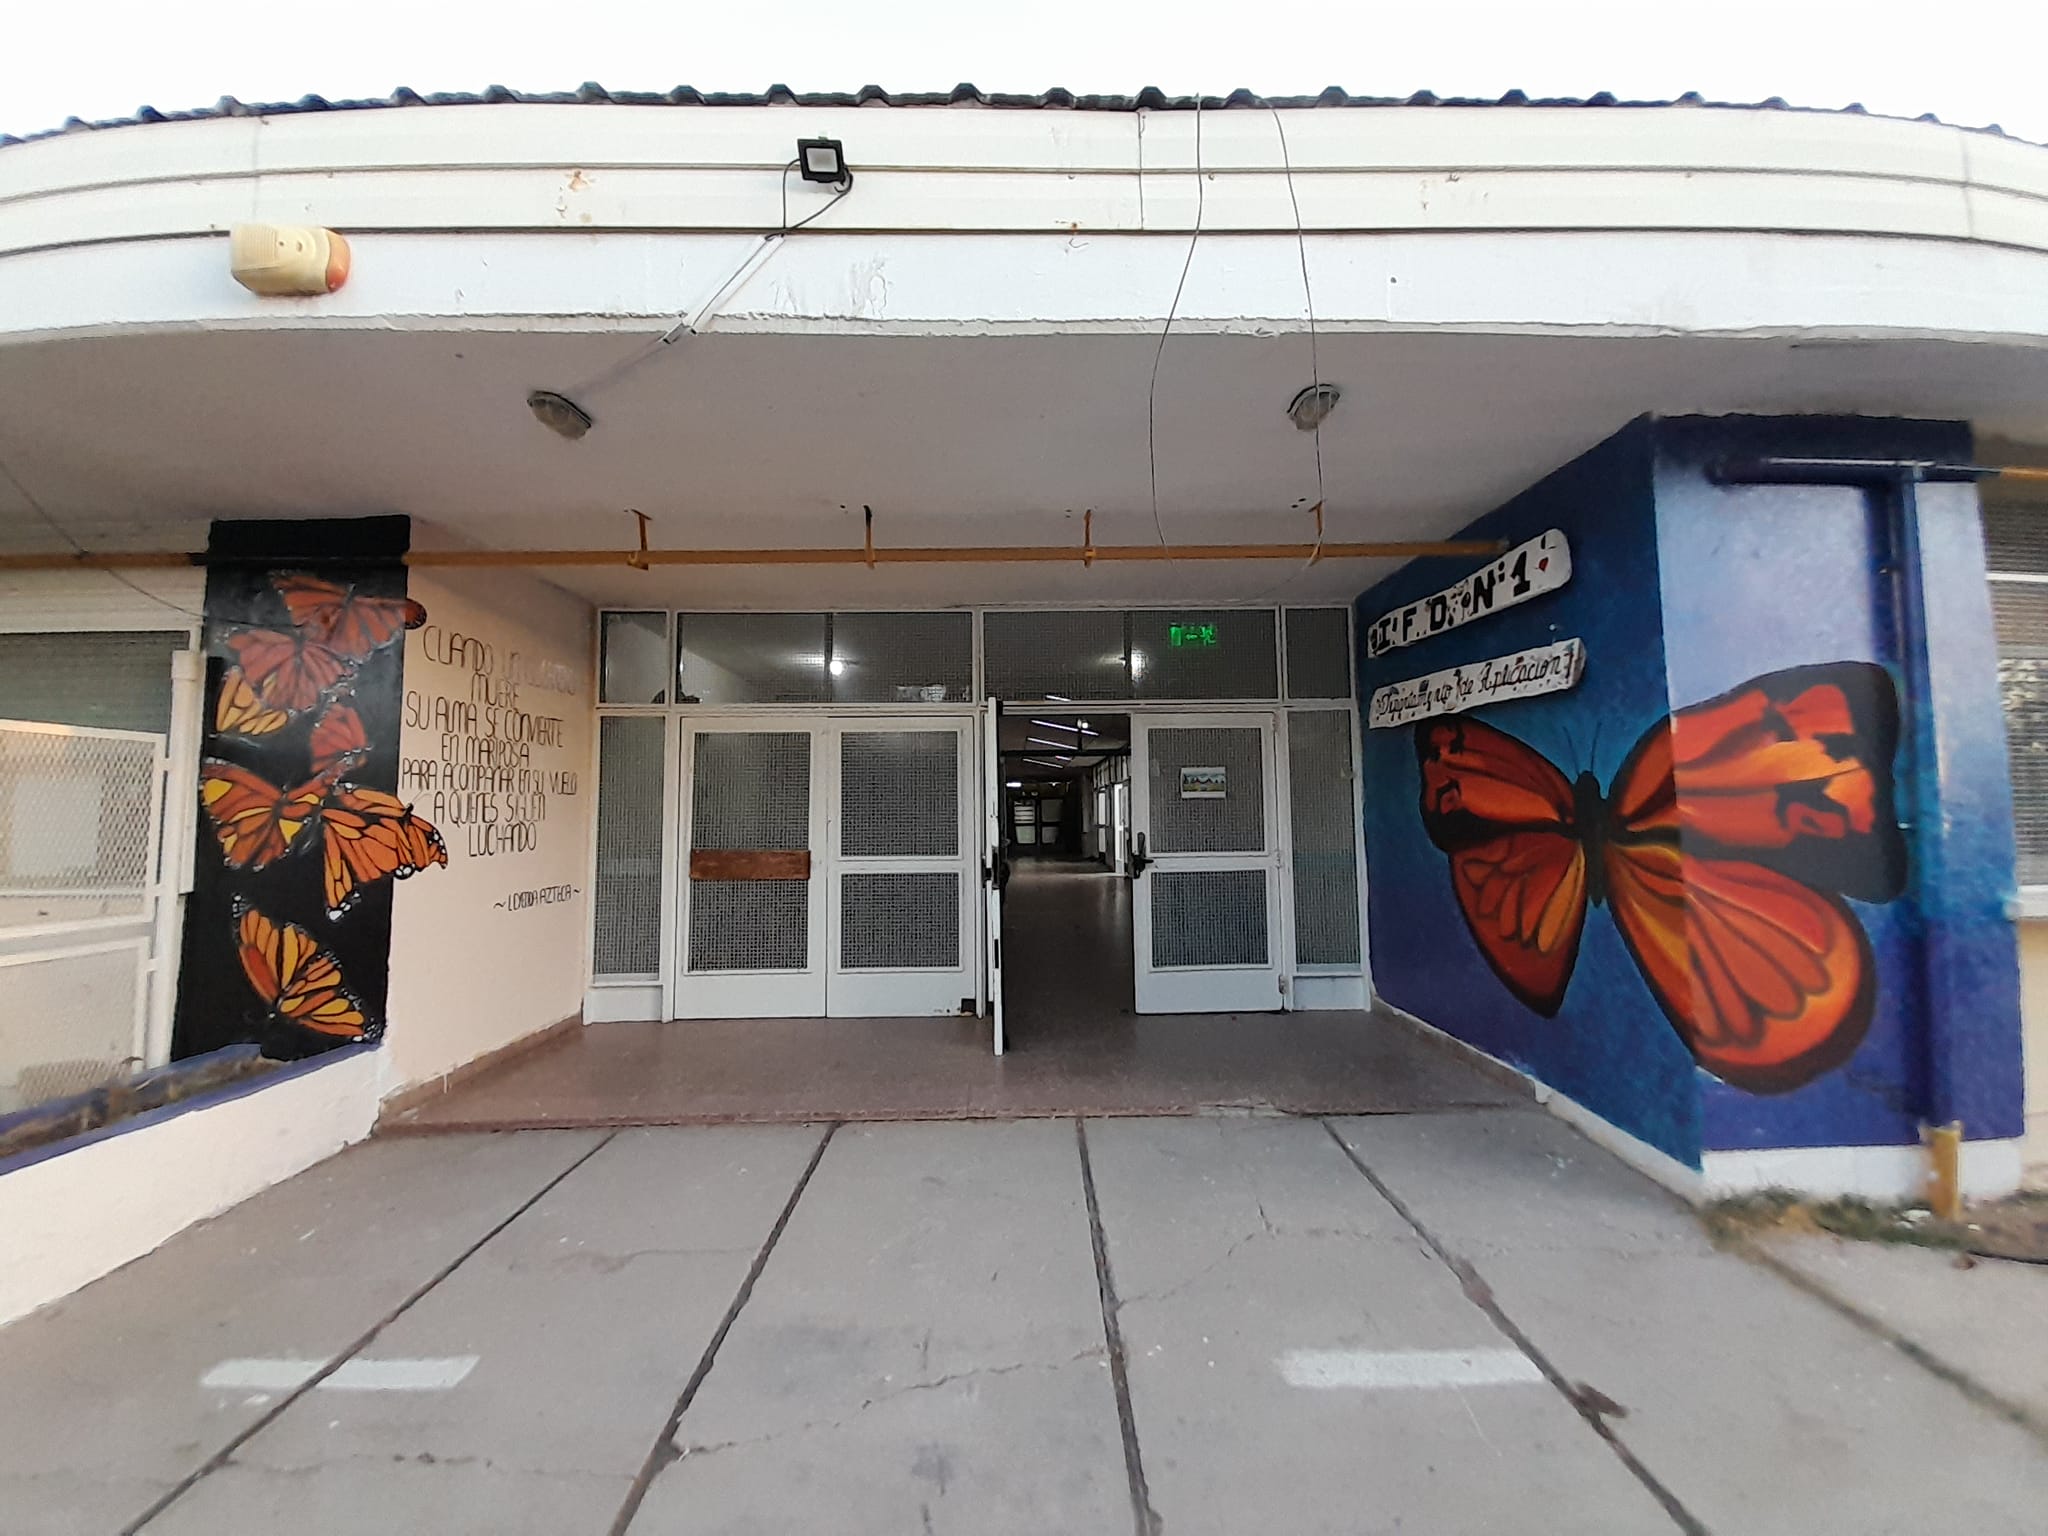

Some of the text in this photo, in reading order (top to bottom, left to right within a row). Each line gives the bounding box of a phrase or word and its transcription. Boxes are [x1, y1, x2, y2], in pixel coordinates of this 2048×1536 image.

[405, 690, 431, 730] SU
[485, 707, 500, 738] SE
[441, 733, 460, 763] EN
[402, 758, 438, 791] PARA
[433, 791, 445, 825] A
[468, 823, 537, 858] LUCHANDO
